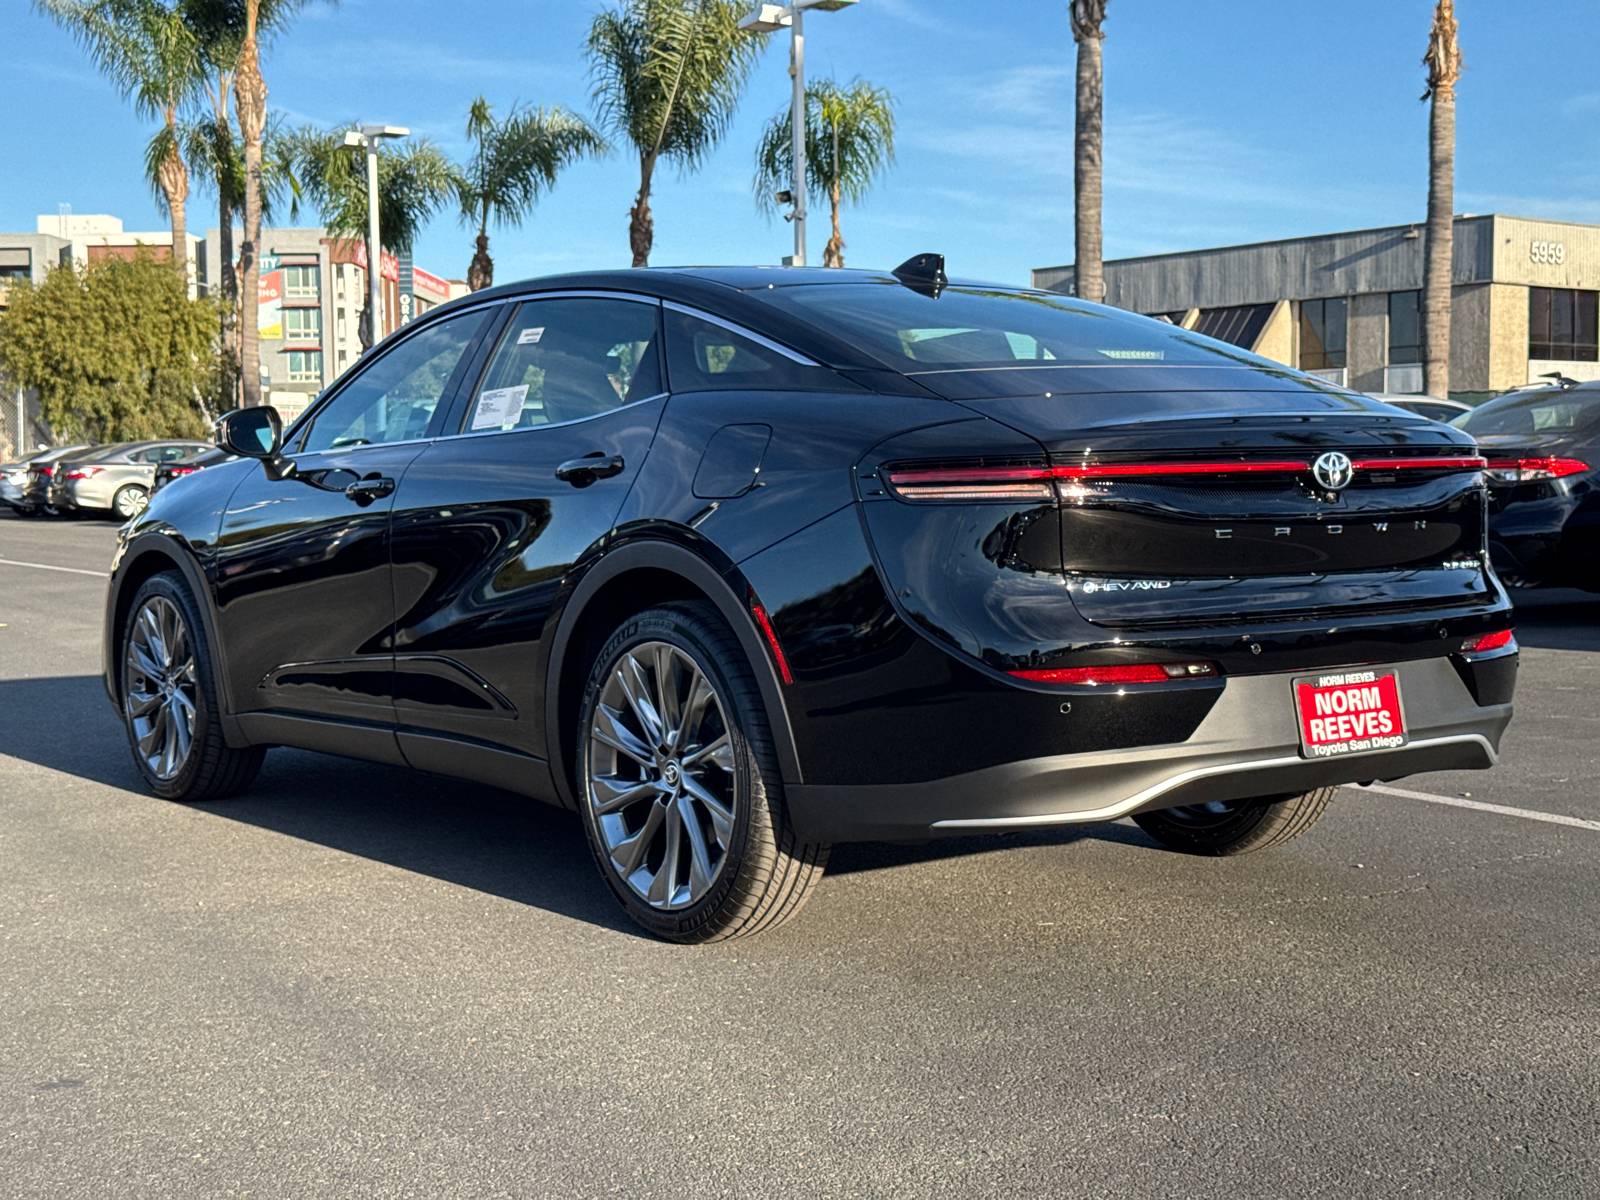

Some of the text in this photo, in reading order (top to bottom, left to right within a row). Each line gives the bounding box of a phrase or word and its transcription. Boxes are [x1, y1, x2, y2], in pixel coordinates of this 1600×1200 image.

[1530, 241, 1564, 264] 5959
[1214, 520, 1427, 539] CROWN
[1319, 671, 1375, 687] NORM REEVES
[1314, 686, 1382, 716] NORM
[1309, 710, 1393, 742] REEVES
[1312, 735, 1404, 756] Toyota San Diego
